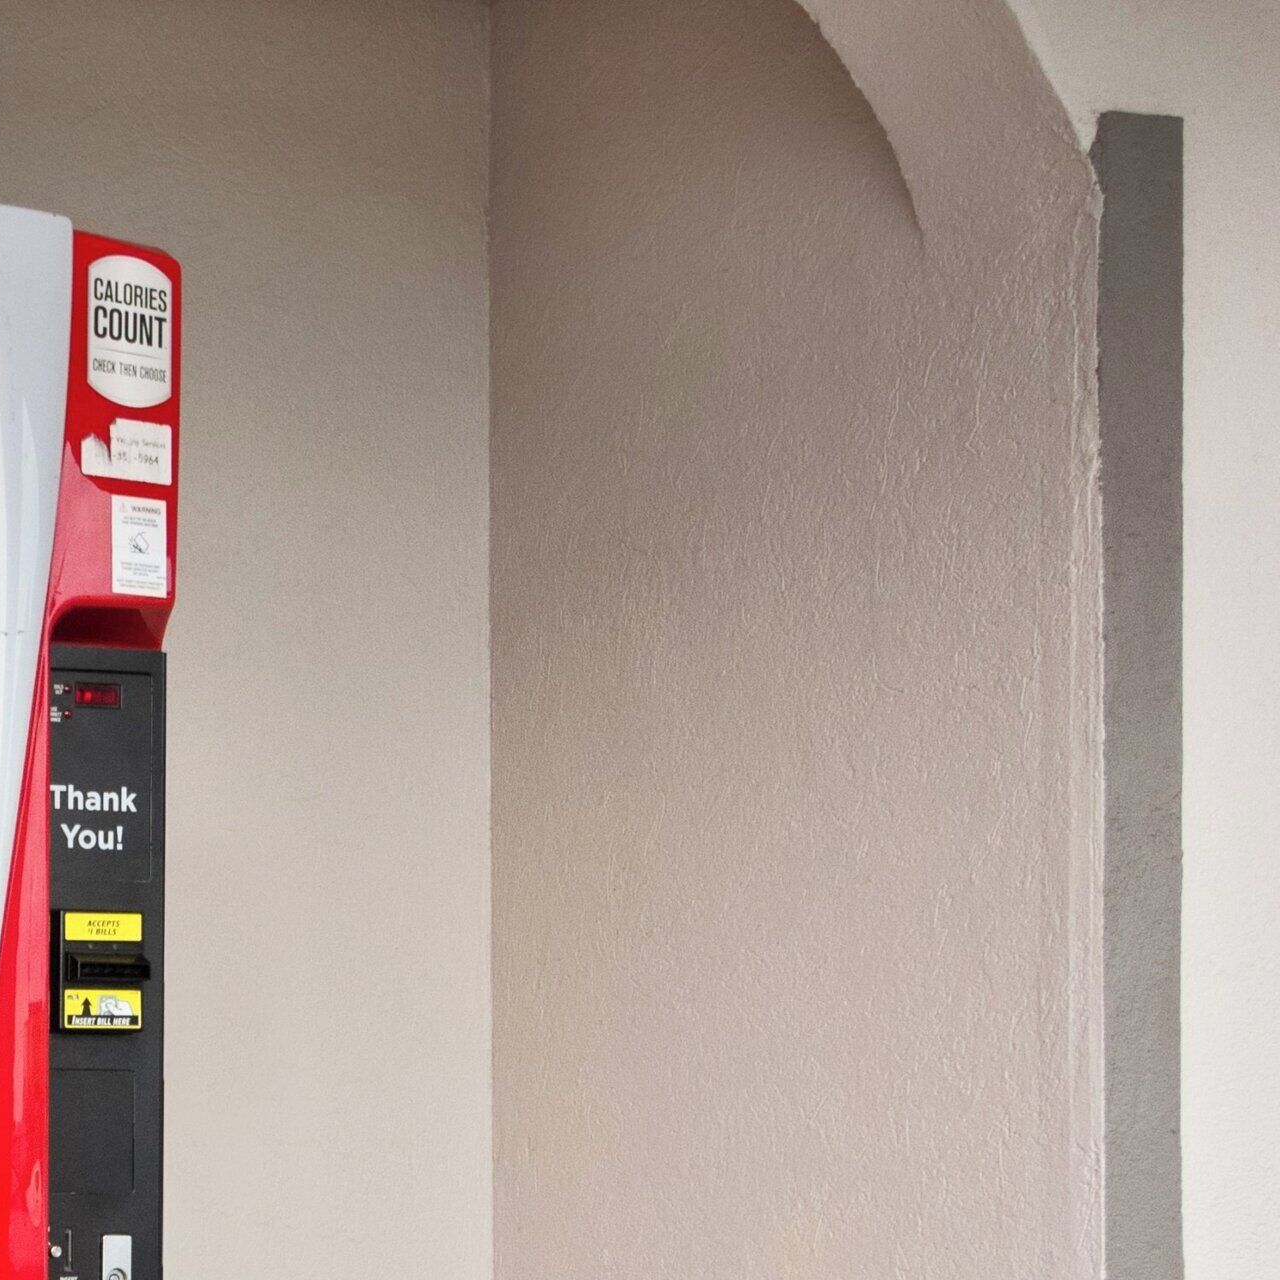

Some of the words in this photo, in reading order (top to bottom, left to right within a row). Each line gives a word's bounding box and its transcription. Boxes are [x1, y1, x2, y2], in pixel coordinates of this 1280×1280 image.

[94, 277, 167, 313] CALORIES
[94, 305, 167, 349] COUNT
[93, 358, 116, 374] CHECK
[119, 362, 138, 378] THEN
[140, 364, 167, 383] CHOOSE
[50, 784, 137, 813] Thank
[60, 823, 123, 851] You!
[87, 919, 120, 928] ACCEPTS
[95, 928, 117, 936] BILLS
[71, 1015, 95, 1025] INSERT
[96, 1016, 111, 1025] BILL
[112, 1016, 131, 1026] HERE
